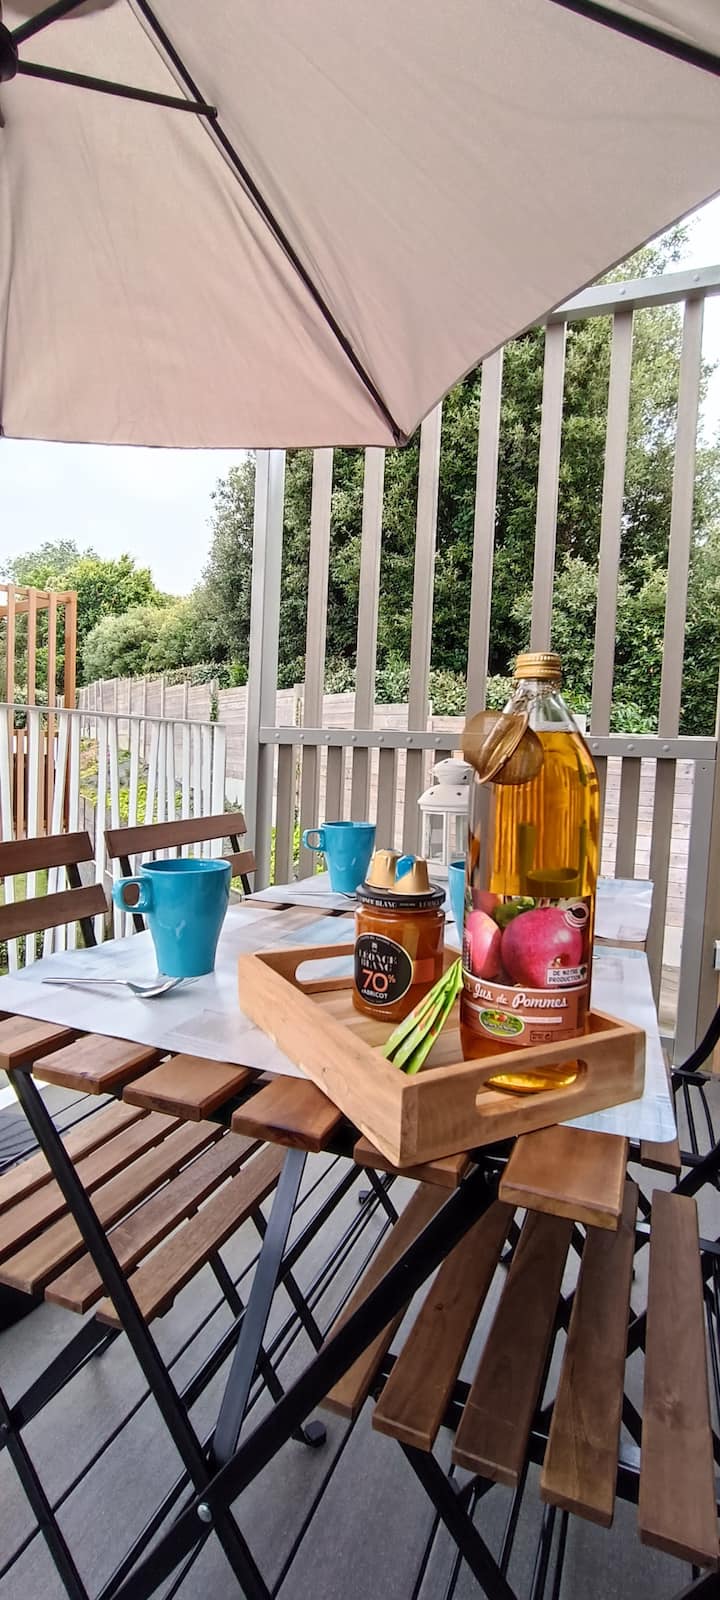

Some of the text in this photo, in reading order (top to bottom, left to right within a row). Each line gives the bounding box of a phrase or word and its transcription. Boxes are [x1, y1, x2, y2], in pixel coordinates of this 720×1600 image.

[375, 899, 397, 909] BLANC
[361, 958, 392, 972] BLANC
[562, 968, 579, 976] NOTRE
[362, 969, 397, 992] 70%
[548, 974, 581, 983] PRODUCTION
[473, 983, 494, 1001] Jus
[496, 993, 508, 1005] de
[512, 992, 568, 1009] Pommes
